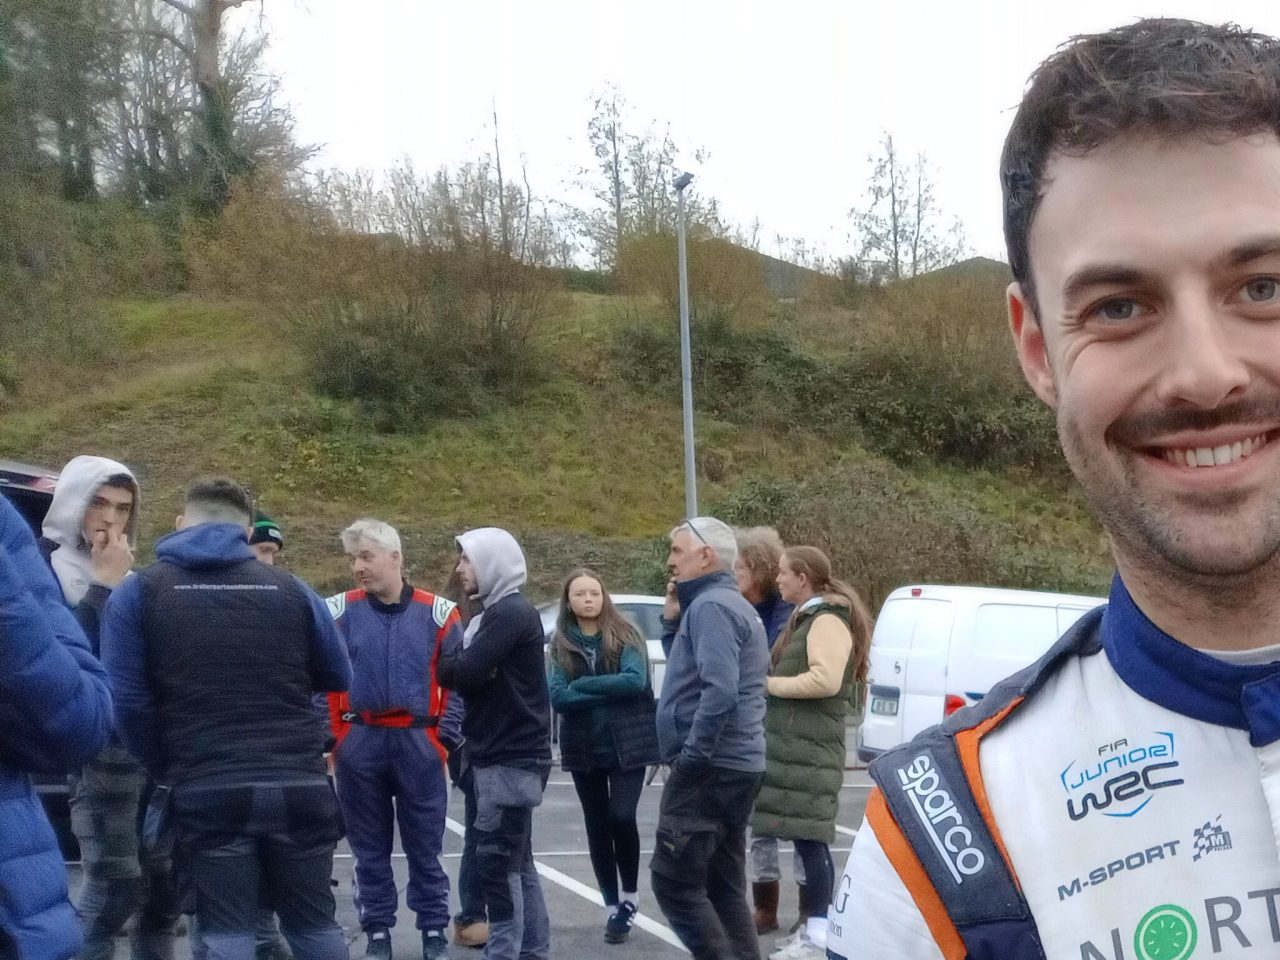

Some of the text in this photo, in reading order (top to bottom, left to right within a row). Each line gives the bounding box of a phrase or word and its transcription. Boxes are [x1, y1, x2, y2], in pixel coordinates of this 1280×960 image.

[1071, 744, 1168, 789] JUNIOR
[1098, 738, 1128, 756] FIA
[898, 755, 985, 883] sparco
[1067, 761, 1185, 821] WRC
[1057, 840, 1181, 901] M-SPORT
